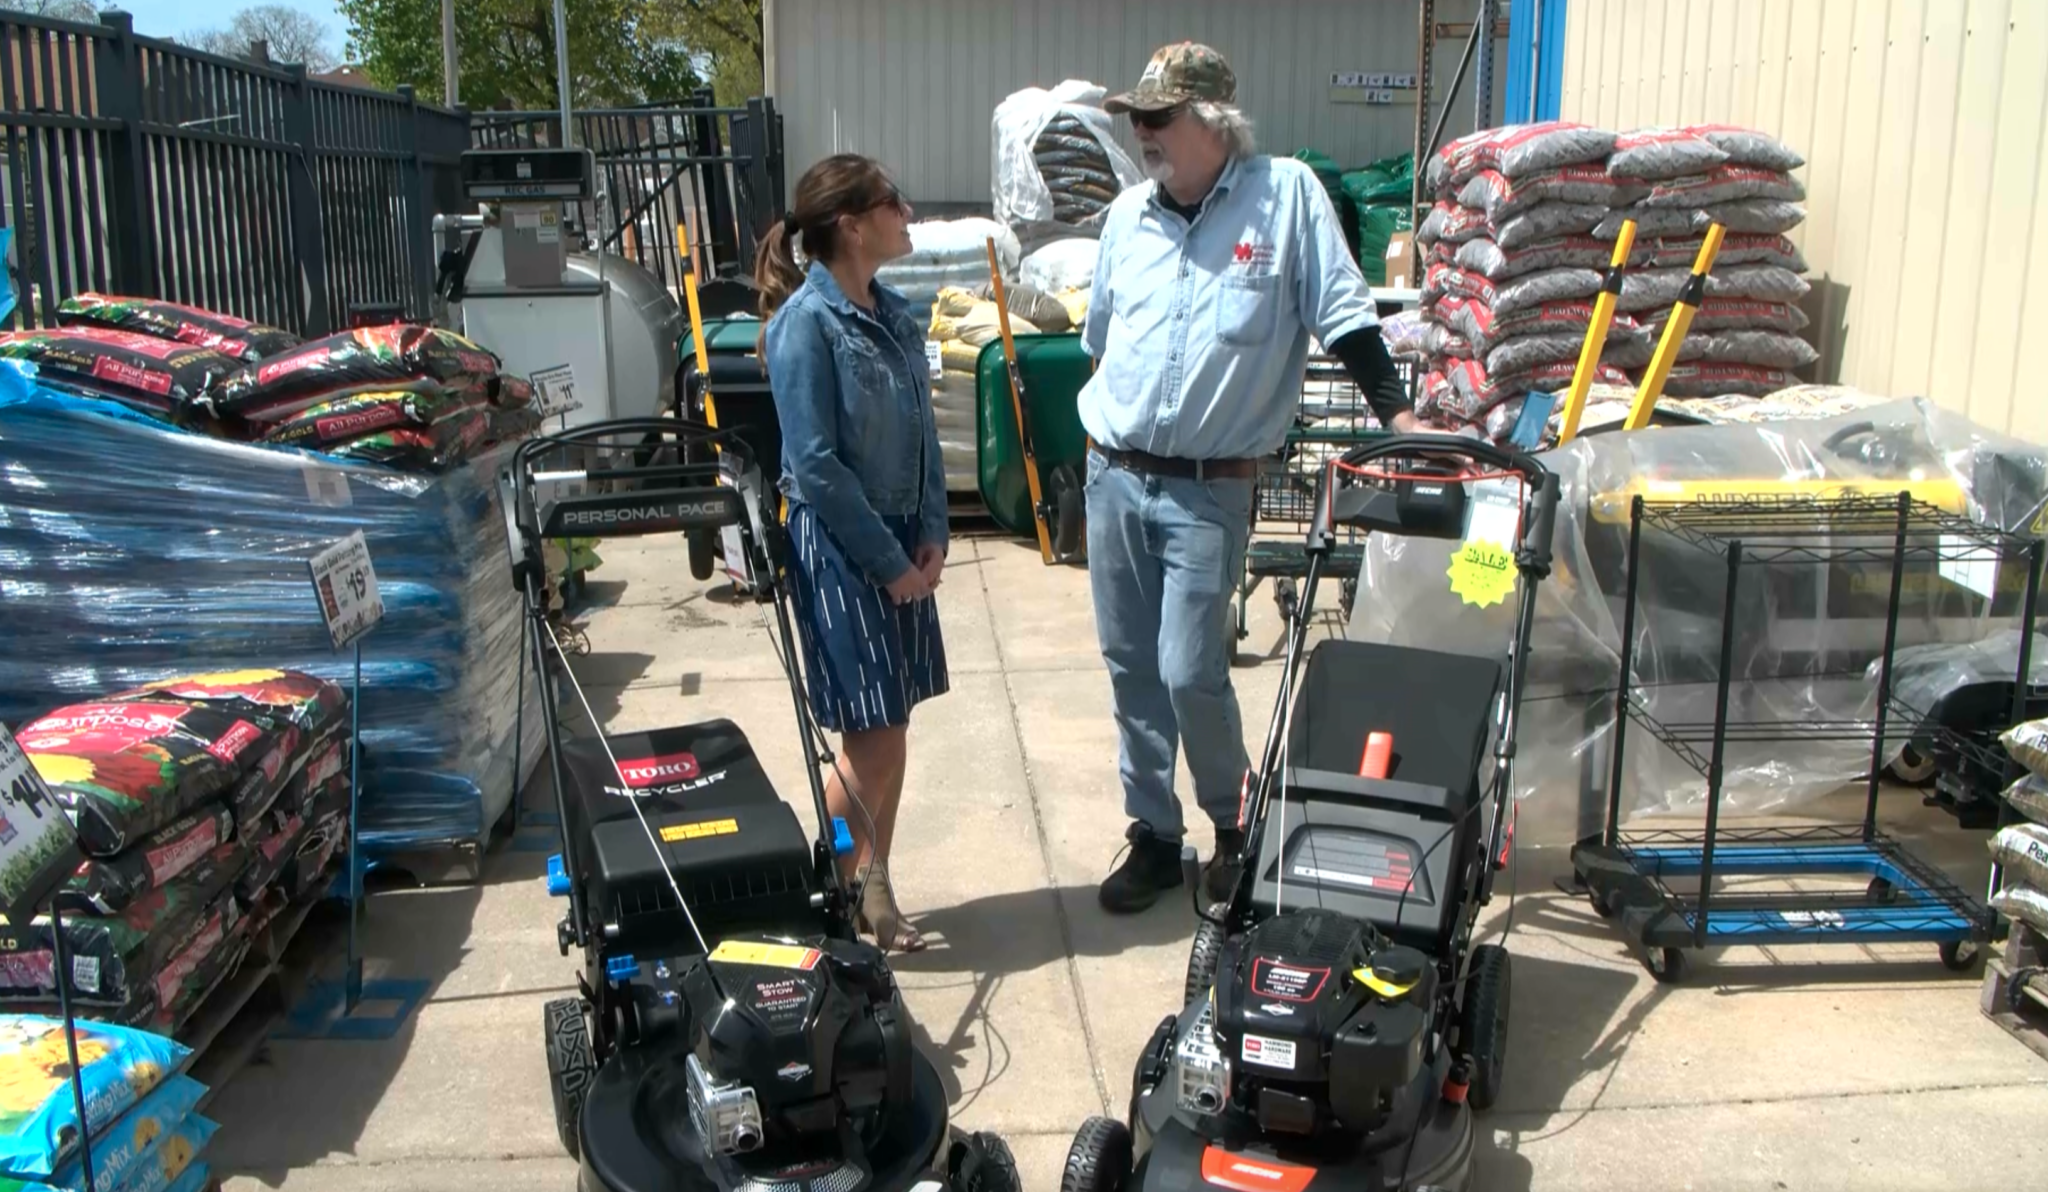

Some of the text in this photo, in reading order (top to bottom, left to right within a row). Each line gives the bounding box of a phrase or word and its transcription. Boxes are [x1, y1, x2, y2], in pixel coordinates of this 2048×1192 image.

[504, 185, 546, 195] REC GAS
[105, 363, 120, 375] All
[121, 365, 166, 387] Purpose
[328, 406, 397, 432] All Purpose
[563, 501, 726, 525] PERSONAL PACE
[1465, 547, 1508, 570] SALE
[623, 761, 691, 780] TORO
[603, 769, 727, 797] RECYCLER
[153, 826, 179, 845] BLACK
[756, 979, 795, 991] SMART
[762, 986, 794, 998] STOW
[755, 996, 807, 1009] GUARANTEED
[778, 1003, 799, 1011] START
[112, 1078, 131, 1102] Mix
[109, 1144, 131, 1175] Mix
